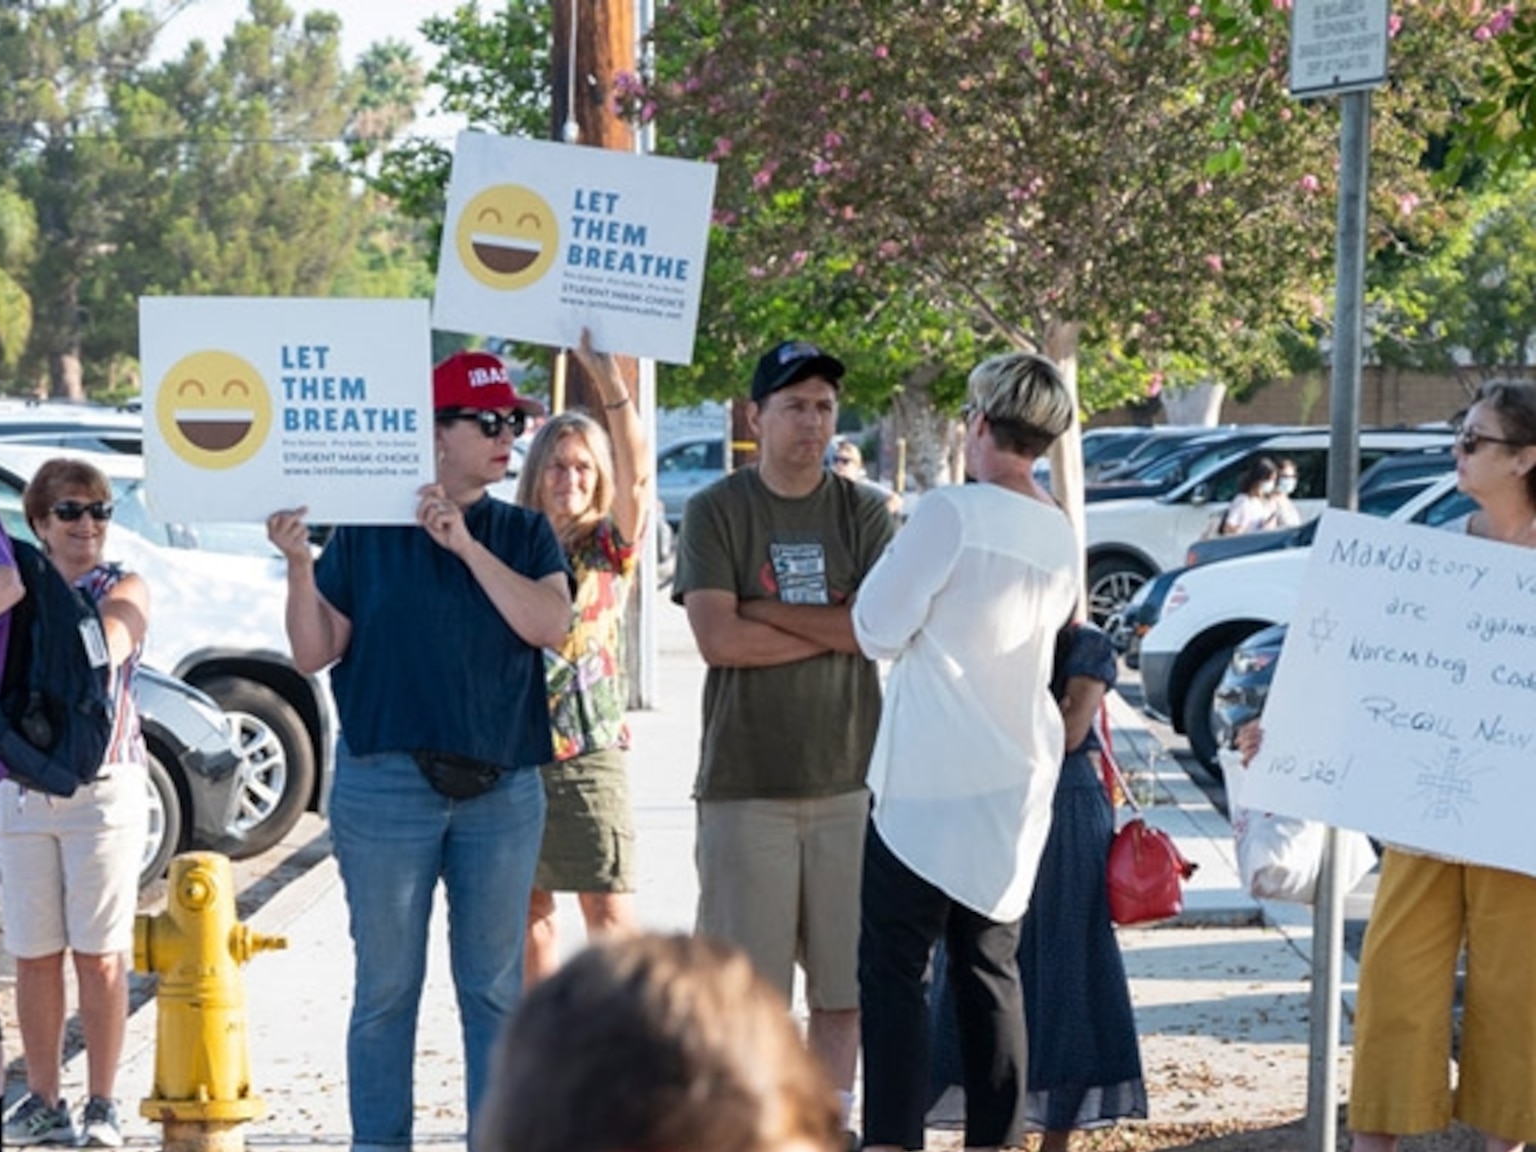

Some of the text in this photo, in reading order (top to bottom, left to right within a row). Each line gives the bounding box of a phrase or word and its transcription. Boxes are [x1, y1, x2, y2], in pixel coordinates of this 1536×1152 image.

[574, 189, 619, 214] LET
[571, 215, 647, 247] THEM
[567, 244, 690, 281] BREATHE
[282, 346, 329, 369] LET
[282, 376, 366, 400] THEM
[284, 408, 417, 432] BREATHE
[1385, 597, 1428, 619] are
